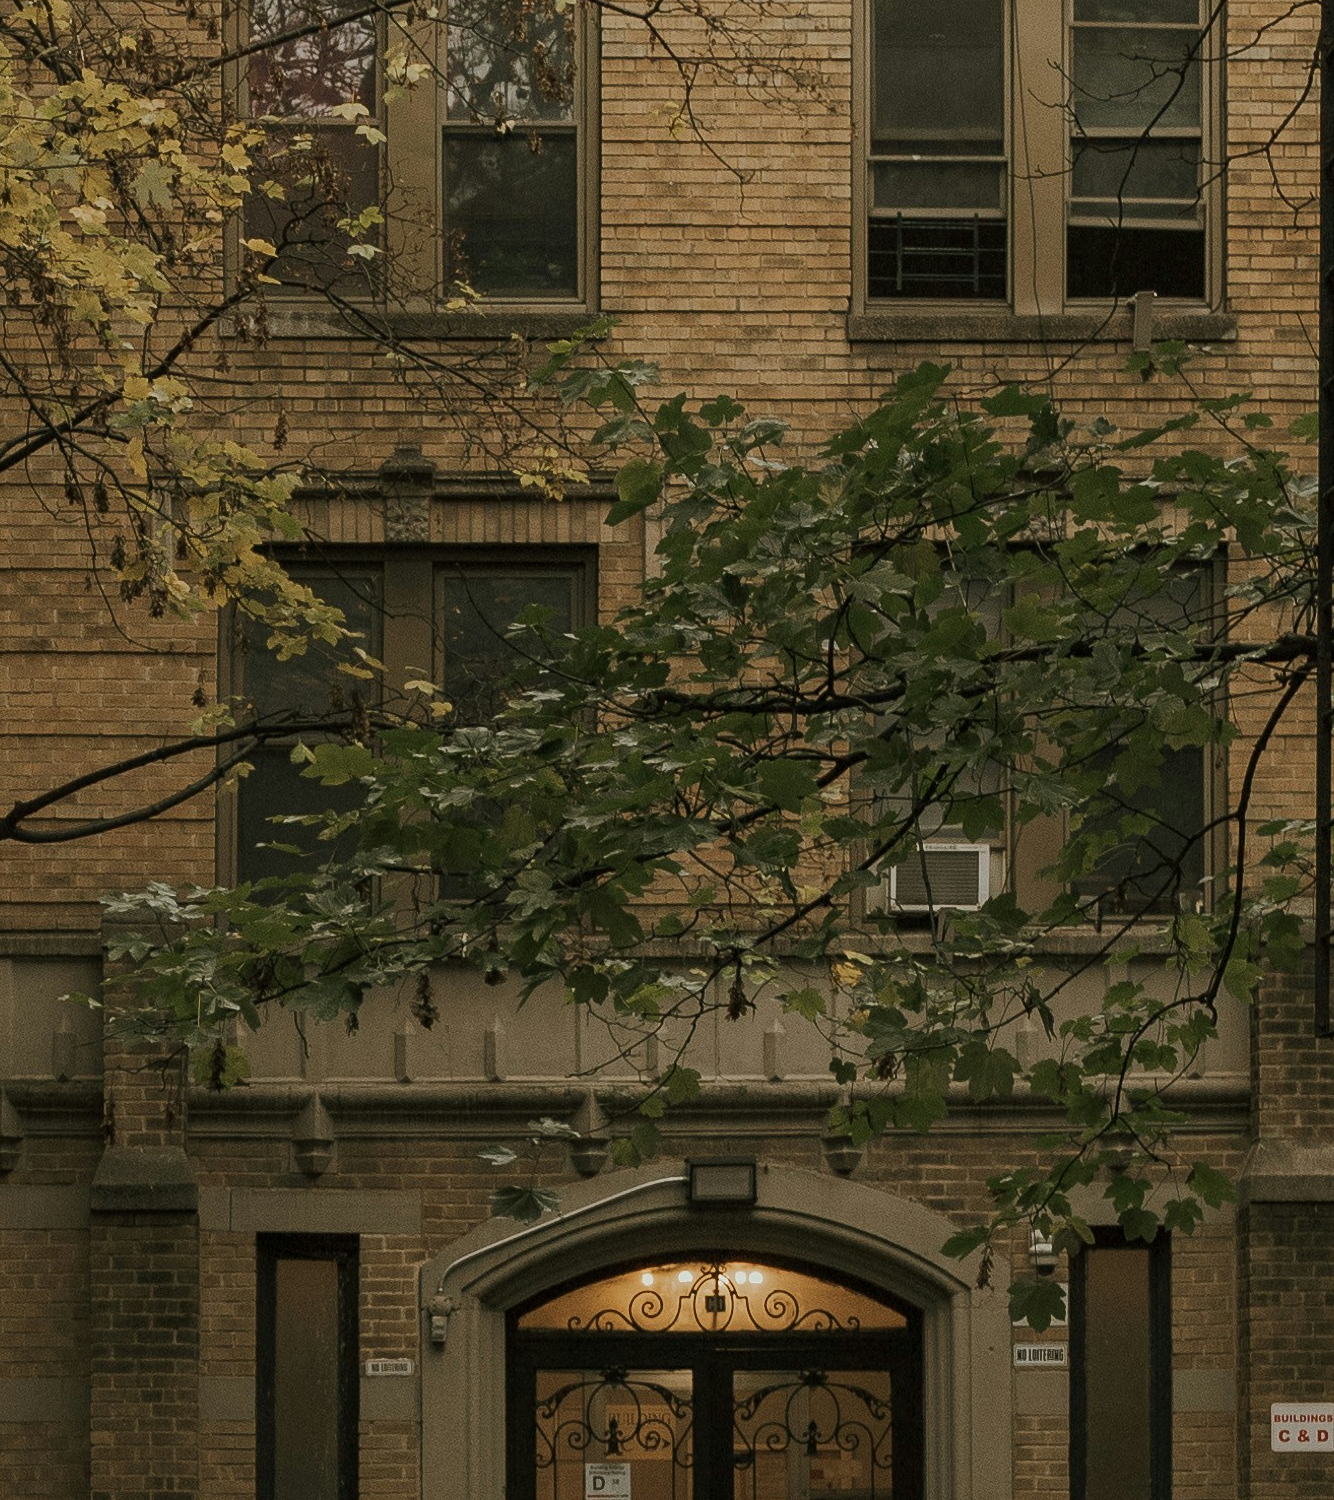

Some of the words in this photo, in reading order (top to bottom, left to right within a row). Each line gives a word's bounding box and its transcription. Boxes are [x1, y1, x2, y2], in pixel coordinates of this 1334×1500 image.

[1016, 1348, 1027, 1361] NO
[1028, 1348, 1064, 1361] LOITERING
[1274, 1414, 1333, 1423] BUILDINGS
[1278, 1429, 1290, 1442] C
[1297, 1429, 1310, 1442] &
[1317, 1429, 1329, 1442] D
[593, 1476, 605, 1491] D
